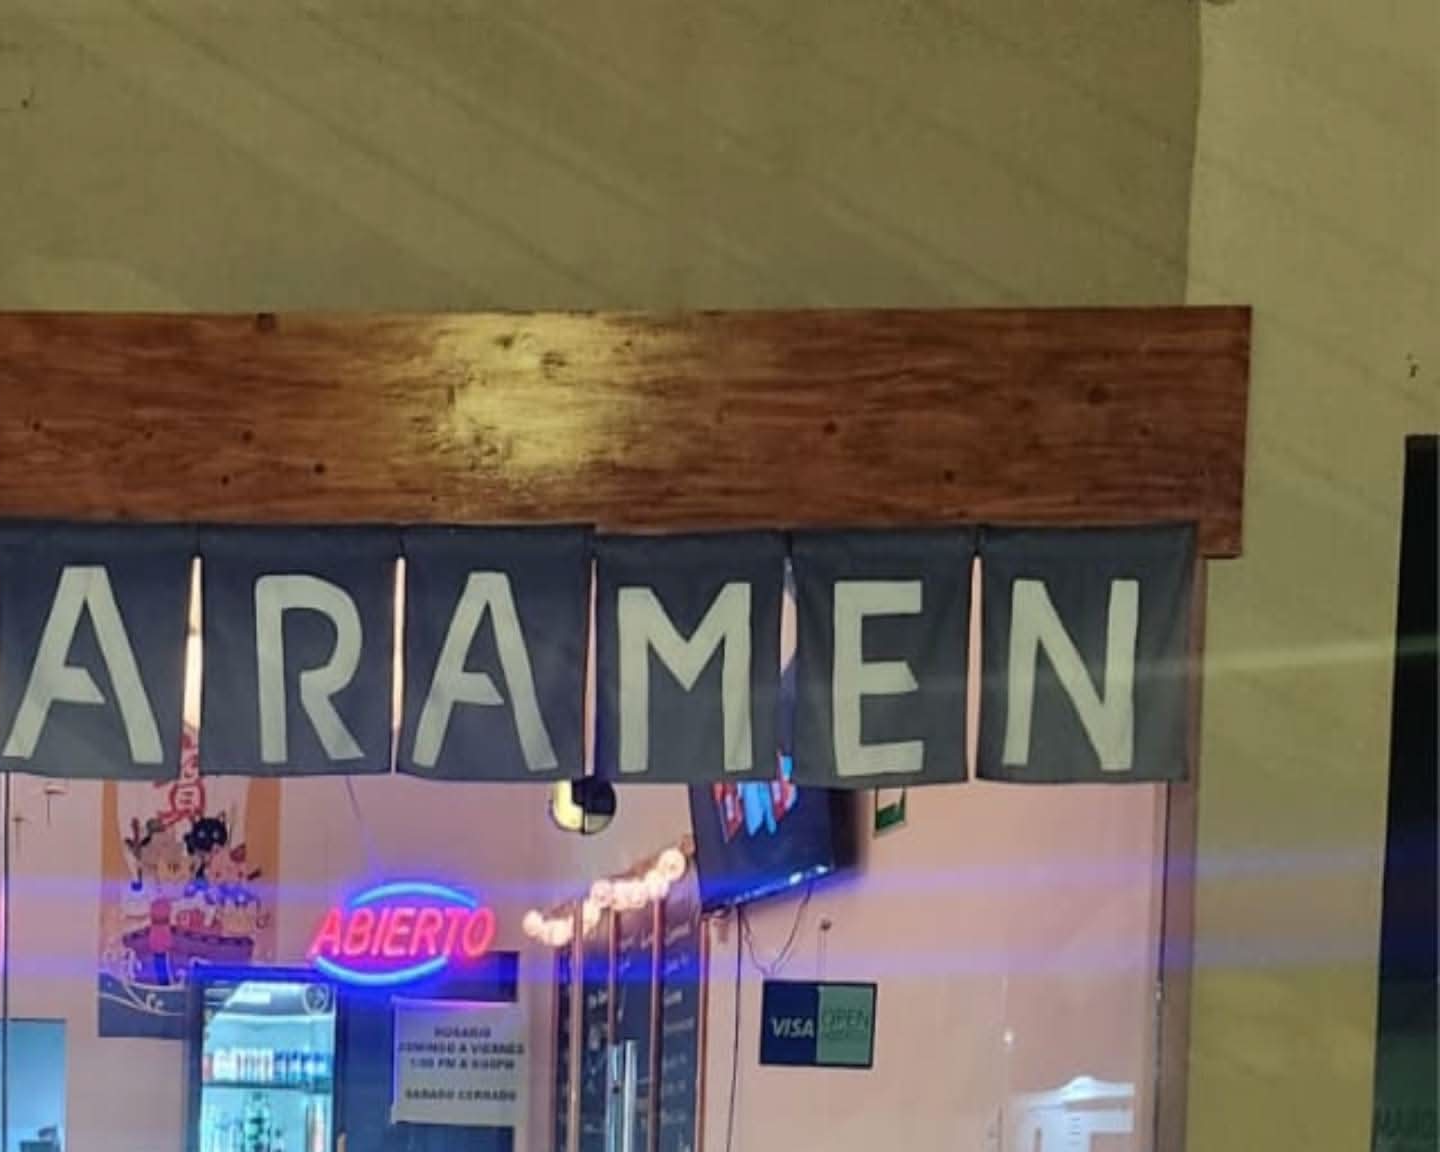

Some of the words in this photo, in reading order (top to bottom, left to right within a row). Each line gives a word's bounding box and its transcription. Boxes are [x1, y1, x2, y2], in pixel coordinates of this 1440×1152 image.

[254, 570, 1141, 775] RAMEN
[309, 905, 497, 959] ABIERTO
[771, 1017, 815, 1038] VISA
